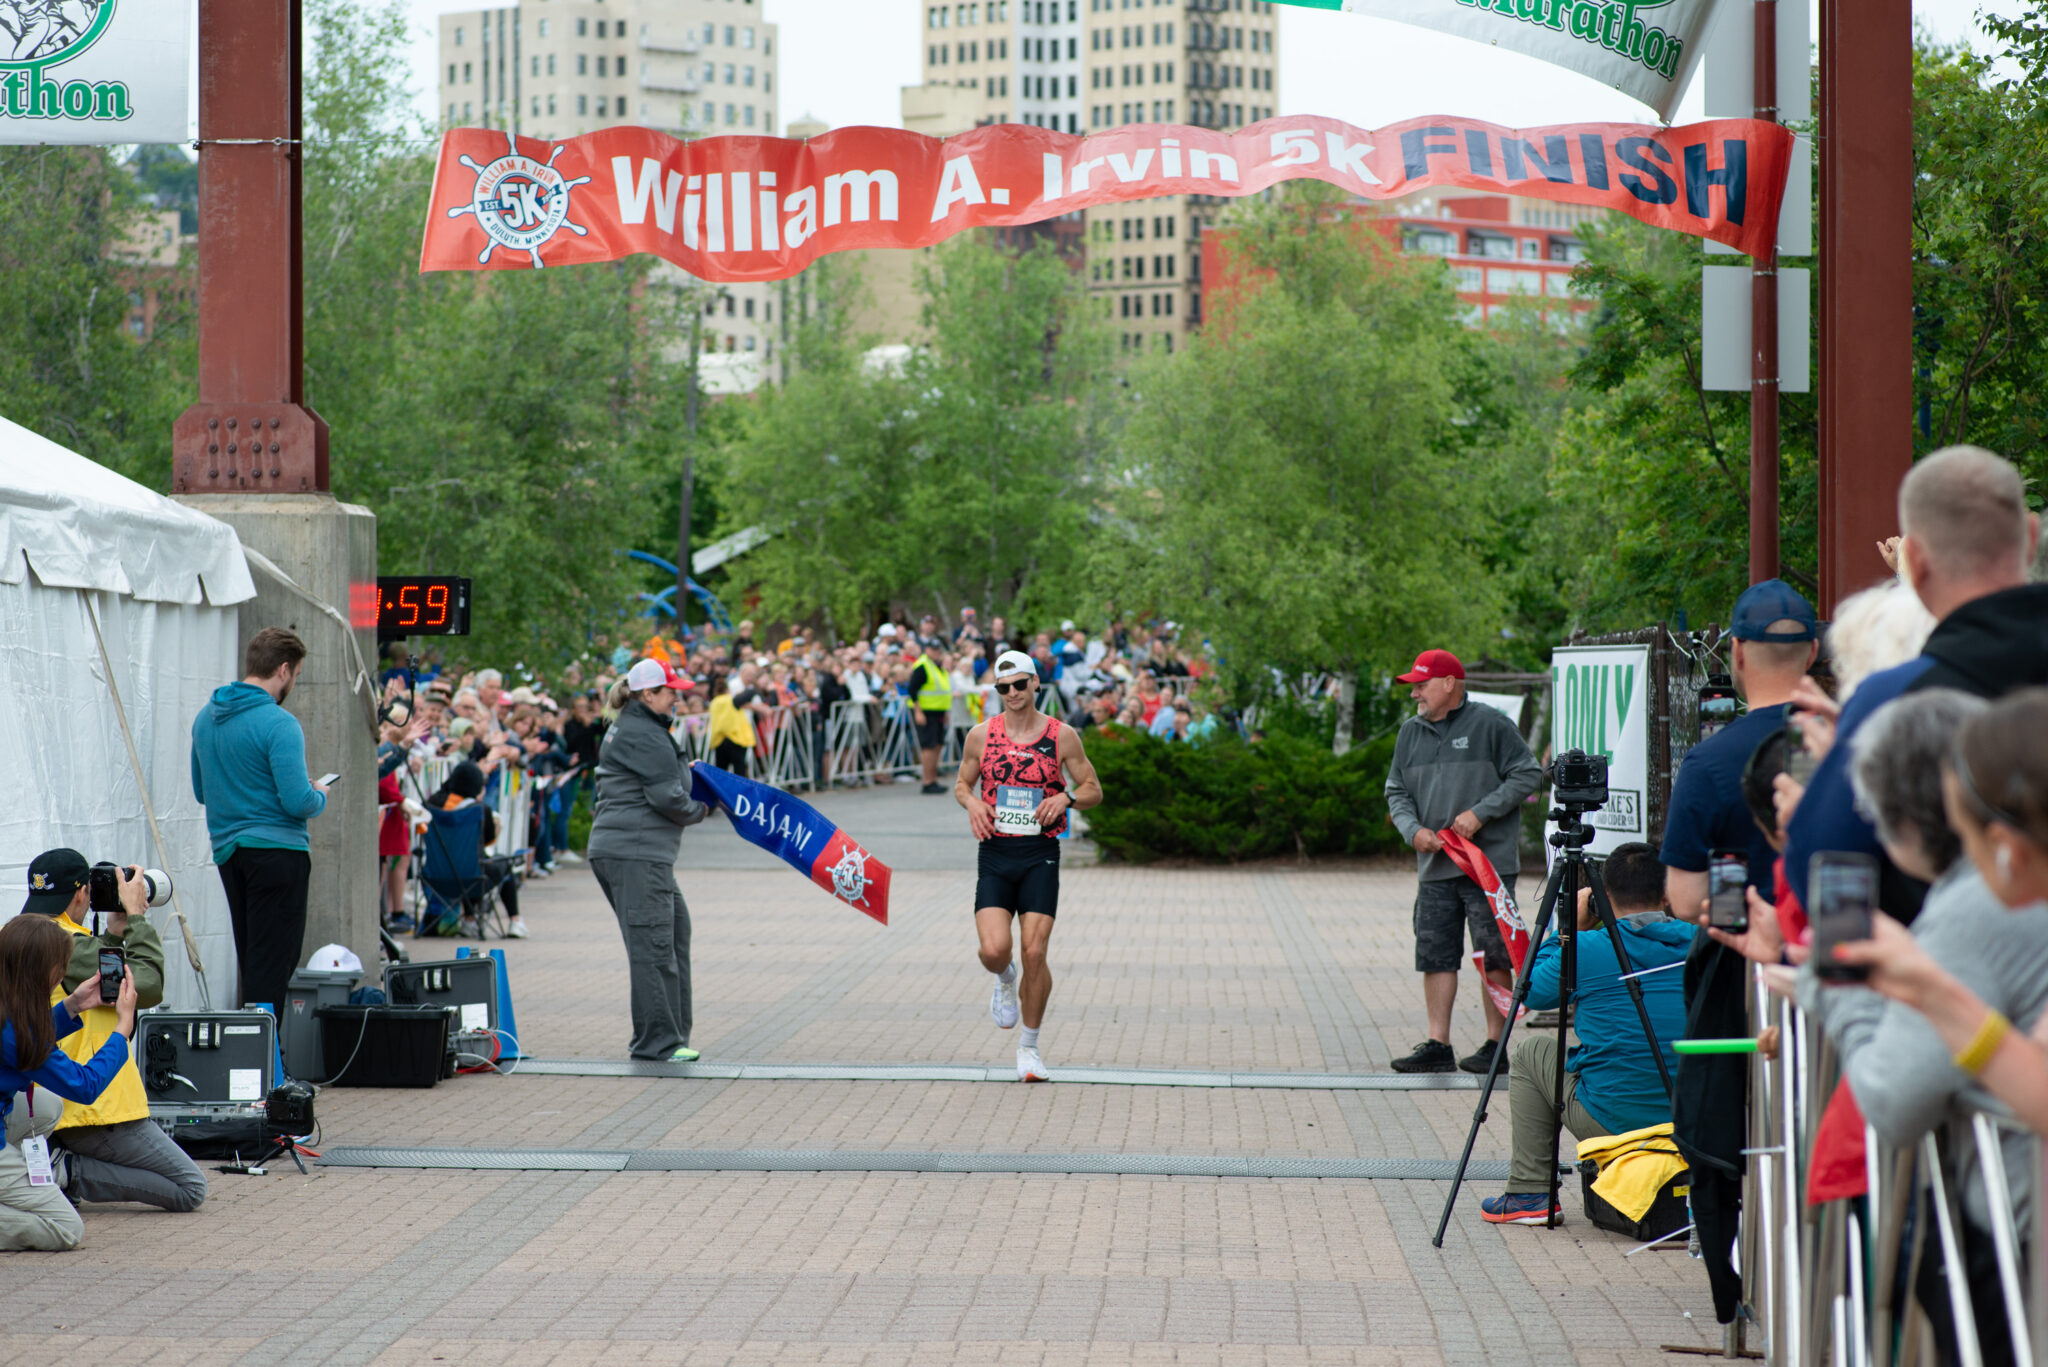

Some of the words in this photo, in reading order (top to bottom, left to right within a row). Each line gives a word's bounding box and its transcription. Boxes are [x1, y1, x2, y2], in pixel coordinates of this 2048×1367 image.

[0, 62, 133, 120] thon
[479, 159, 517, 194] WILLIAM
[611, 155, 899, 253] William
[930, 154, 1010, 223] A.
[1043, 138, 1240, 202] Irvin
[1400, 126, 1748, 227] FINISH
[499, 183, 548, 229] 5K
[525, 209, 562, 245] MINNESOTA
[734, 793, 813, 851] DASANI
[1000, 811, 1037, 826] 22554
[840, 864, 857, 889] 5K
